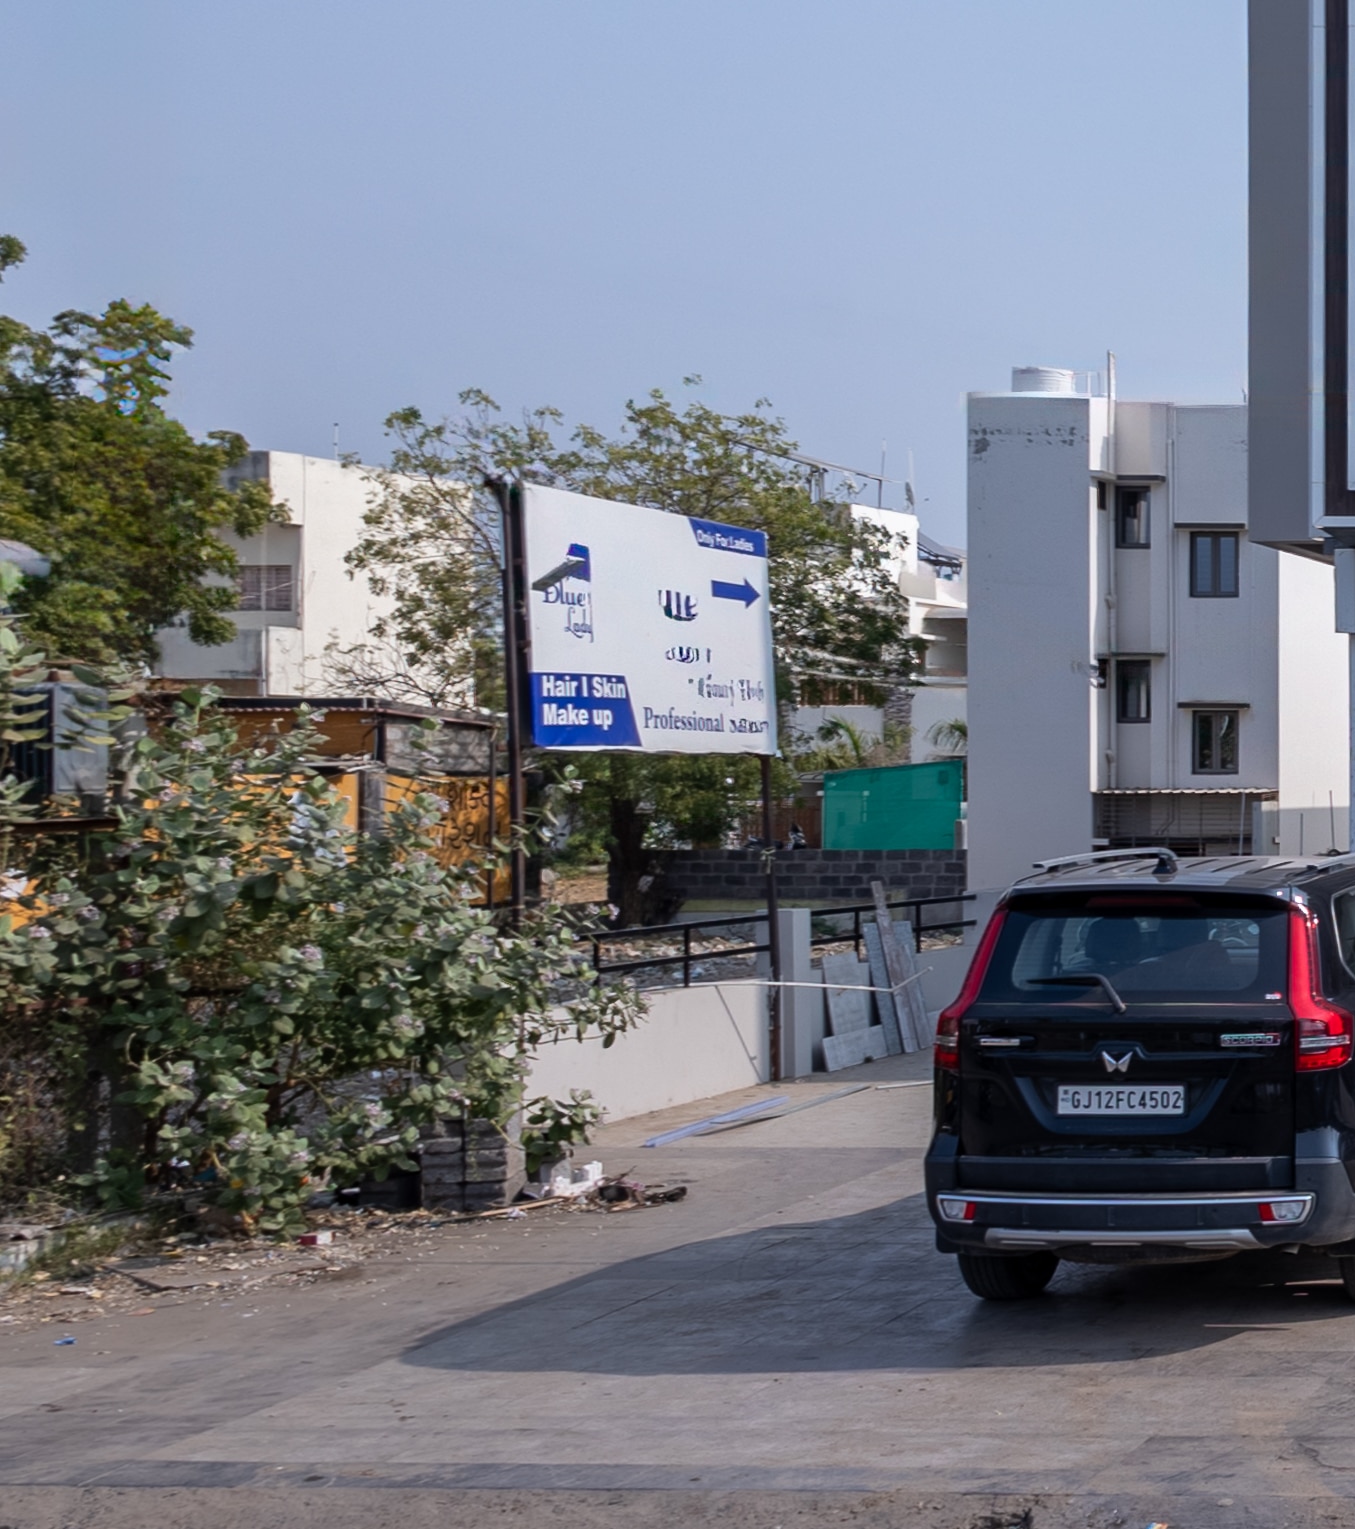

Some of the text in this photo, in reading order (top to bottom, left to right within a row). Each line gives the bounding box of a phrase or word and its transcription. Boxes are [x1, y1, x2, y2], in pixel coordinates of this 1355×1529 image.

[542, 675, 578, 697] Hair
[592, 676, 627, 699] Skin
[542, 703, 613, 731] Make up
[643, 706, 725, 733] Professional
[1071, 1090, 1182, 1110] GJ12FC4502
